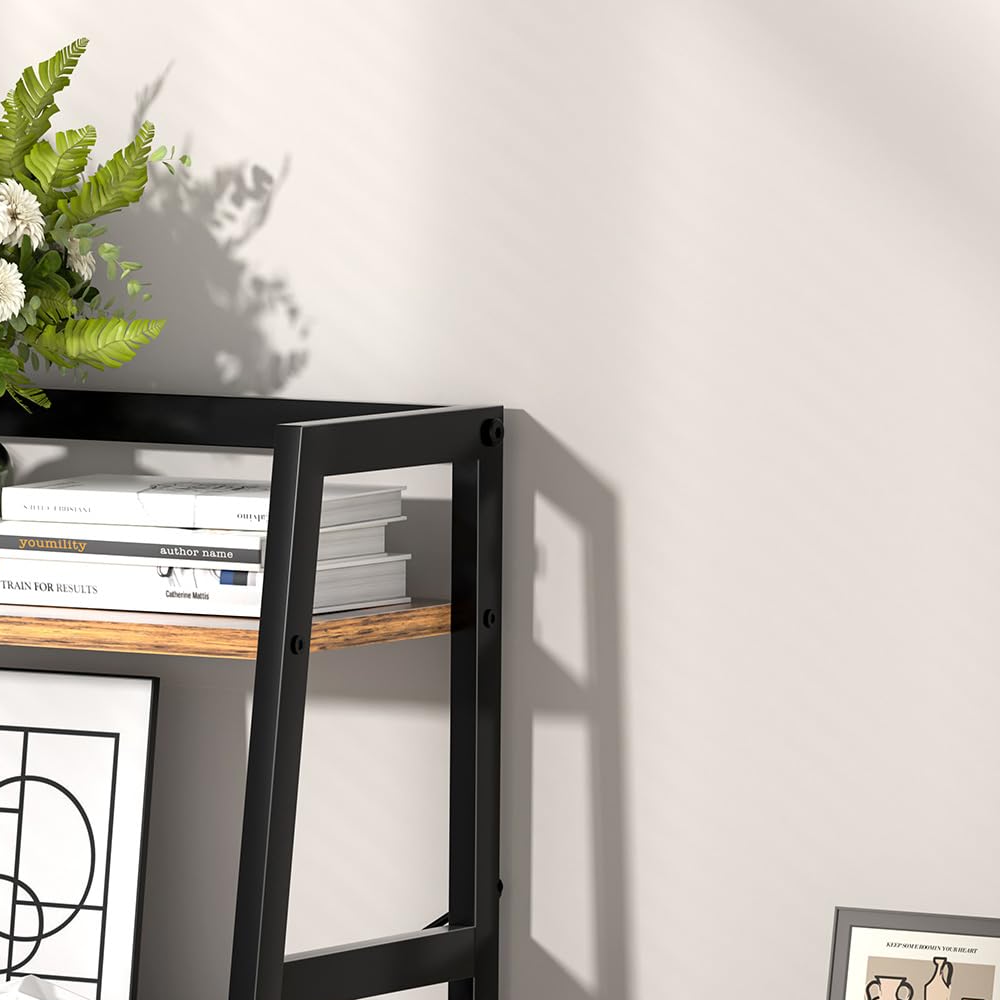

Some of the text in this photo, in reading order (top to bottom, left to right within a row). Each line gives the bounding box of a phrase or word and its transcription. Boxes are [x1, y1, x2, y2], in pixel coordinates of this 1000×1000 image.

[18, 537, 87, 552] youmility
[160, 547, 233, 559] author name
[0, 579, 98, 594] TRAIN FOR RESULTS
[165, 589, 191, 599] Catherine
